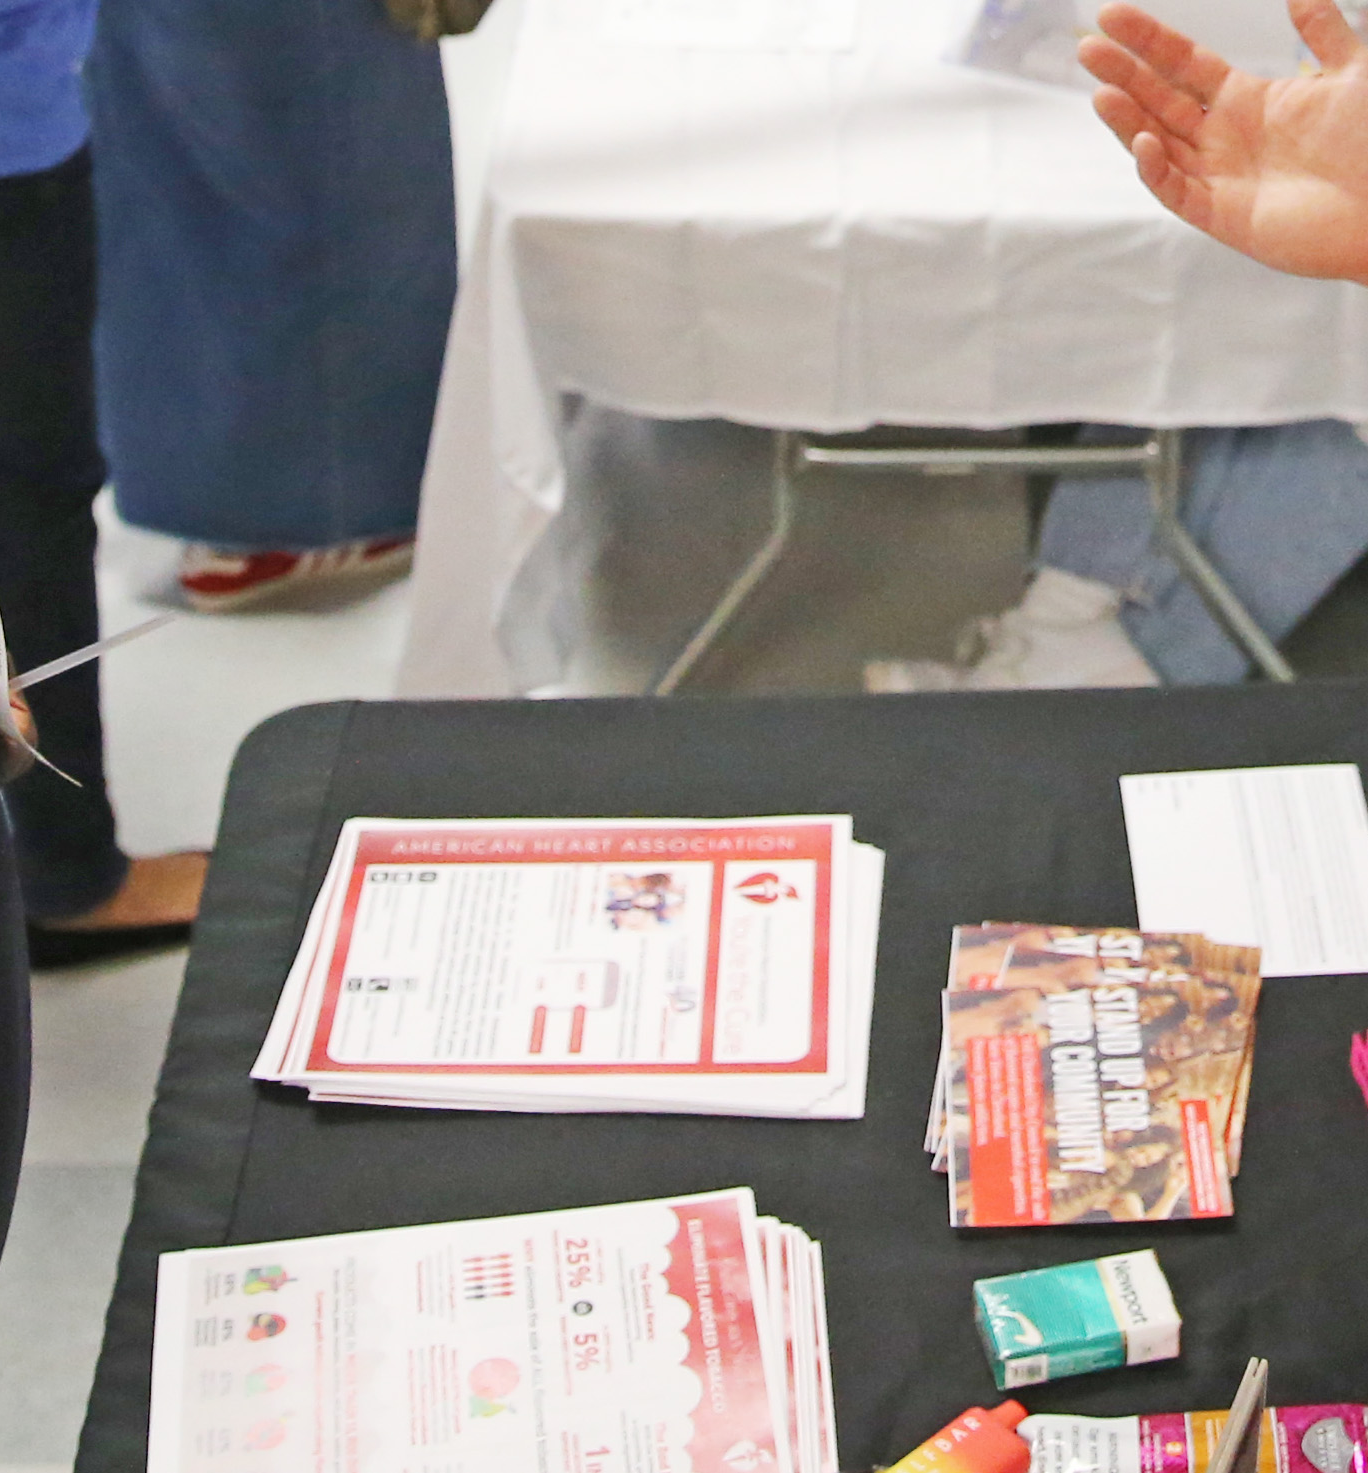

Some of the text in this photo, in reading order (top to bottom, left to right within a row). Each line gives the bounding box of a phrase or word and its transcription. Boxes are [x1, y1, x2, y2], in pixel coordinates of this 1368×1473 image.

[391, 835, 797, 856] AMERICAN HEART ASSOCIATION
[1046, 988, 1094, 1044] YOUR
[1092, 987, 1151, 1132] STAND UP FOR
[1050, 1045, 1106, 1174] COMMUNITY
[565, 1238, 592, 1289] 25%
[1112, 1259, 1148, 1325] Newport
[574, 1332, 599, 1372] 5%
